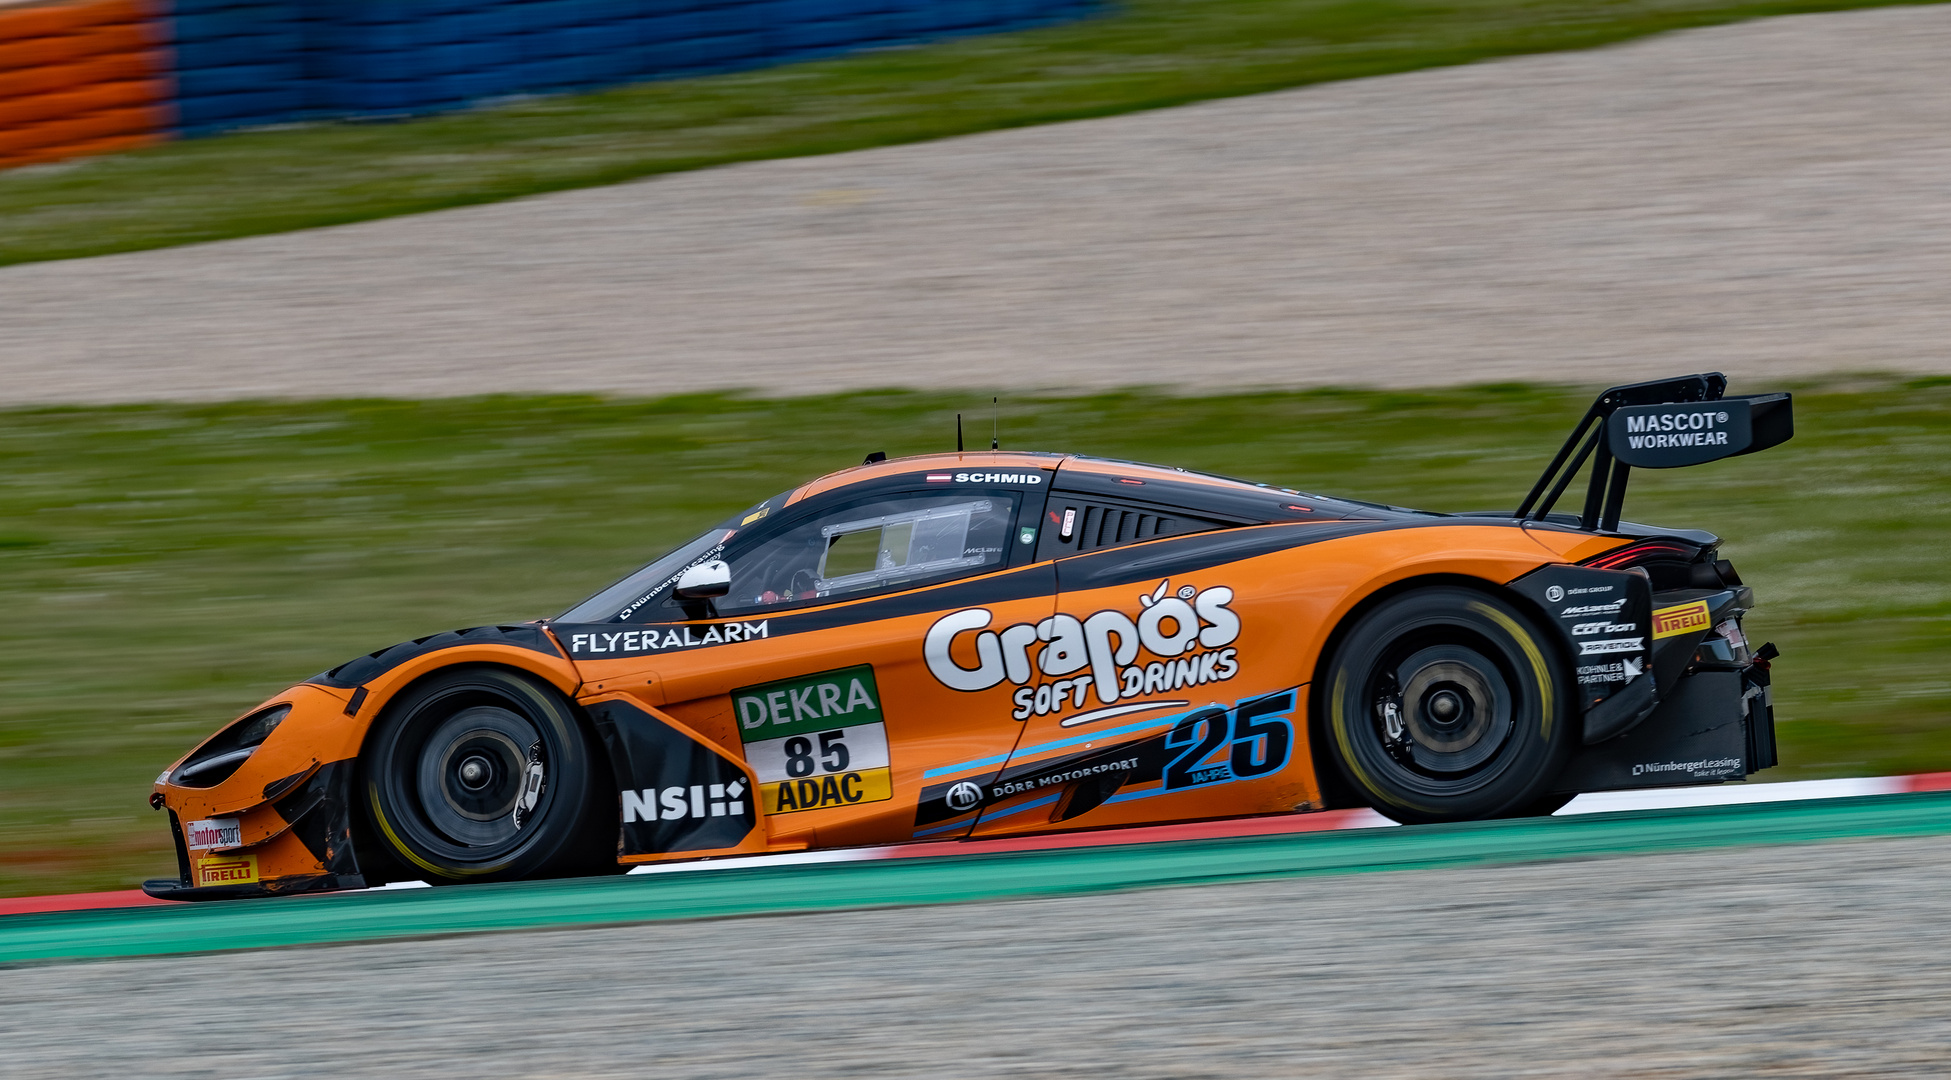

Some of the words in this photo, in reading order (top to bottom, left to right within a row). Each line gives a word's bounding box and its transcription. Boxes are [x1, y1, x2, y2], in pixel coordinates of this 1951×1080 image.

[1628, 432, 1728, 449] WORKWEAR
[955, 473, 1042, 485] SCHMID
[1561, 602, 1622, 615] McLaren
[1652, 605, 1706, 634] PIRELLI
[572, 619, 769, 653] FLYERALARM
[1585, 641, 1639, 652] RAVENOL
[1012, 673, 1093, 721] SOFT
[1121, 648, 1240, 698] DRINKS
[1577, 672, 1625, 684] PARTNER
[737, 678, 877, 730] DEKRA
[783, 730, 850, 778] 85
[1163, 688, 1299, 792] 25
[776, 772, 864, 812] ADAC
[992, 781, 1035, 798] DÖRR
[1039, 757, 1139, 787] MOTORSPORT
[194, 824, 241, 847] motorsport
[199, 860, 251, 882] PIRELLI
